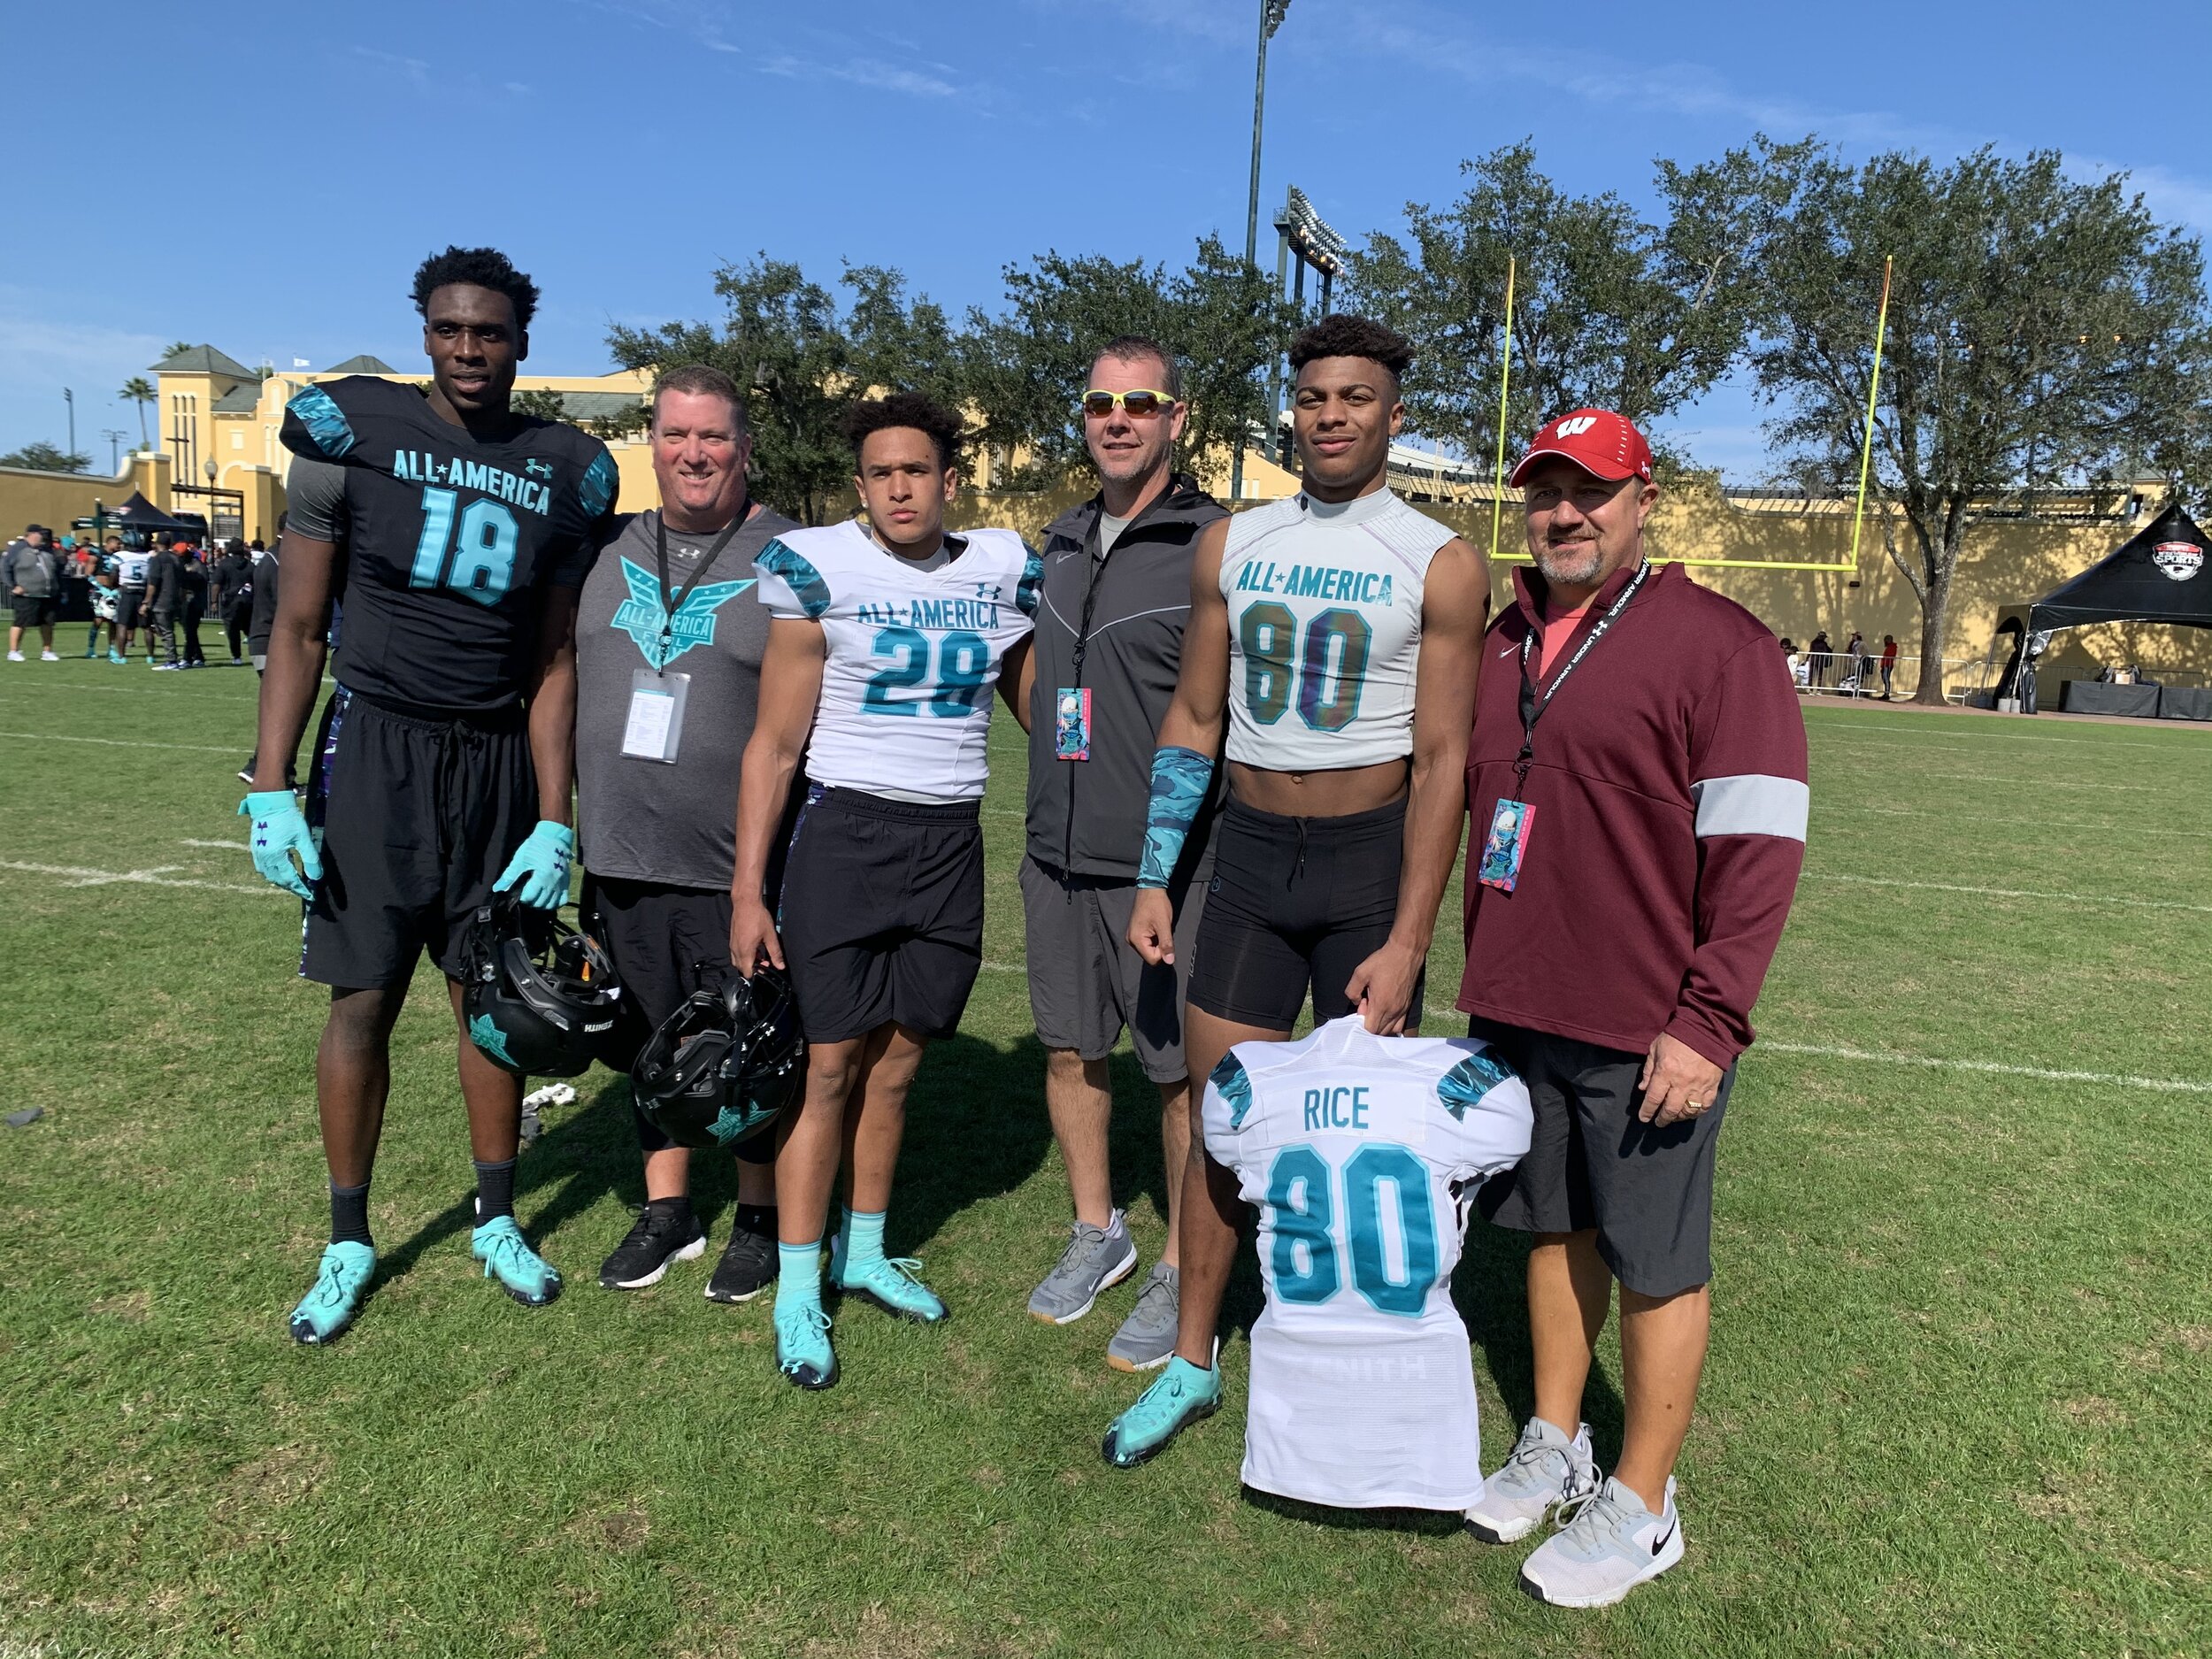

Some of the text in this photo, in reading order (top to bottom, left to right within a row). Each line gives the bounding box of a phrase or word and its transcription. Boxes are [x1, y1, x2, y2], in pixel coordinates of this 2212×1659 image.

[394, 449, 550, 516] ALL AMERICA
[408, 485, 519, 607] 18
[2156, 555, 2200, 565] SPORTS
[131, 565, 142, 580] 5
[1236, 561, 1393, 607] ALL AMERICA
[858, 599, 999, 629] ALL AMERICA
[643, 631, 684, 647] FIL
[1571, 634, 1596, 664] UNDER
[859, 624, 991, 718] 28
[1240, 600, 1373, 733] 80
[1303, 1087, 1370, 1132] RICE
[1265, 1141, 1441, 1318] 80
